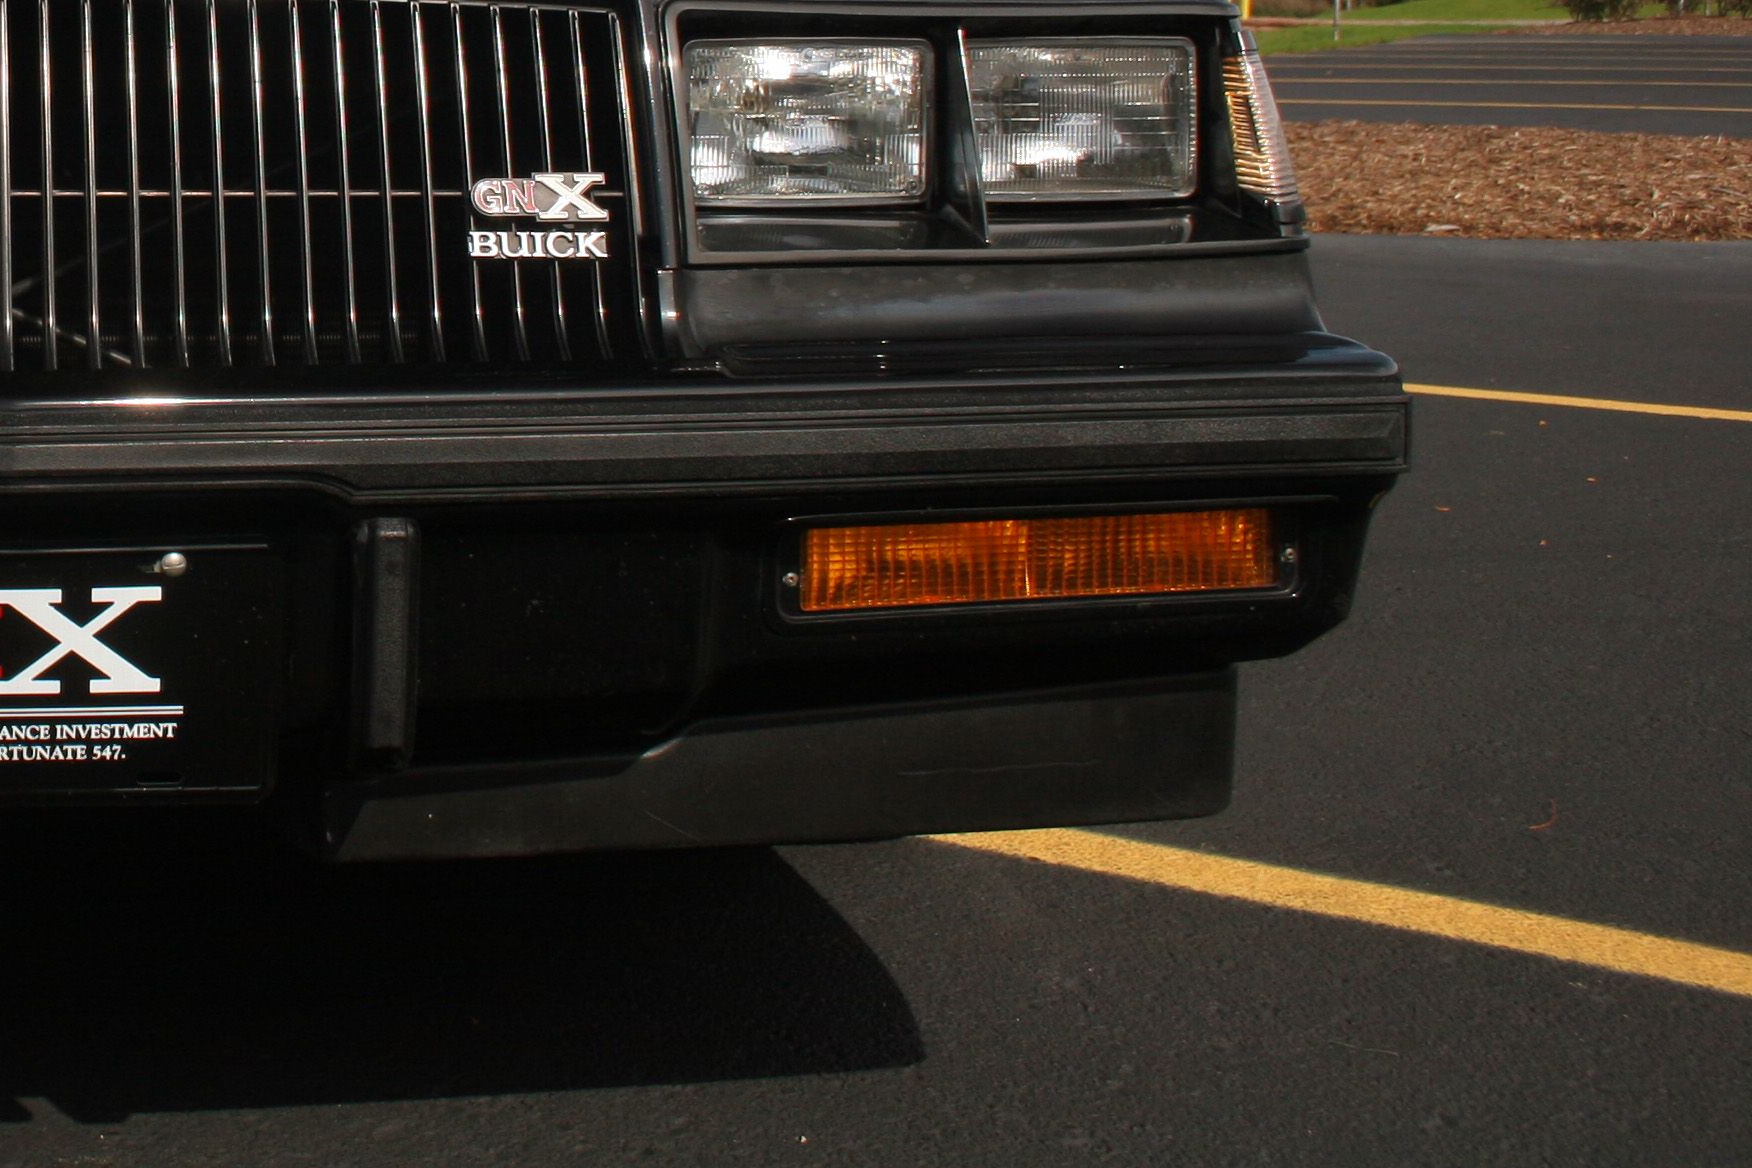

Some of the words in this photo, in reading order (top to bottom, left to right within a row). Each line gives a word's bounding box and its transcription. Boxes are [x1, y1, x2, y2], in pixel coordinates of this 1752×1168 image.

[472, 173, 608, 220] GNX
[469, 231, 608, 258] BUICK
[55, 722, 178, 740] INVESTMENT
[92, 743, 126, 761] 547.
